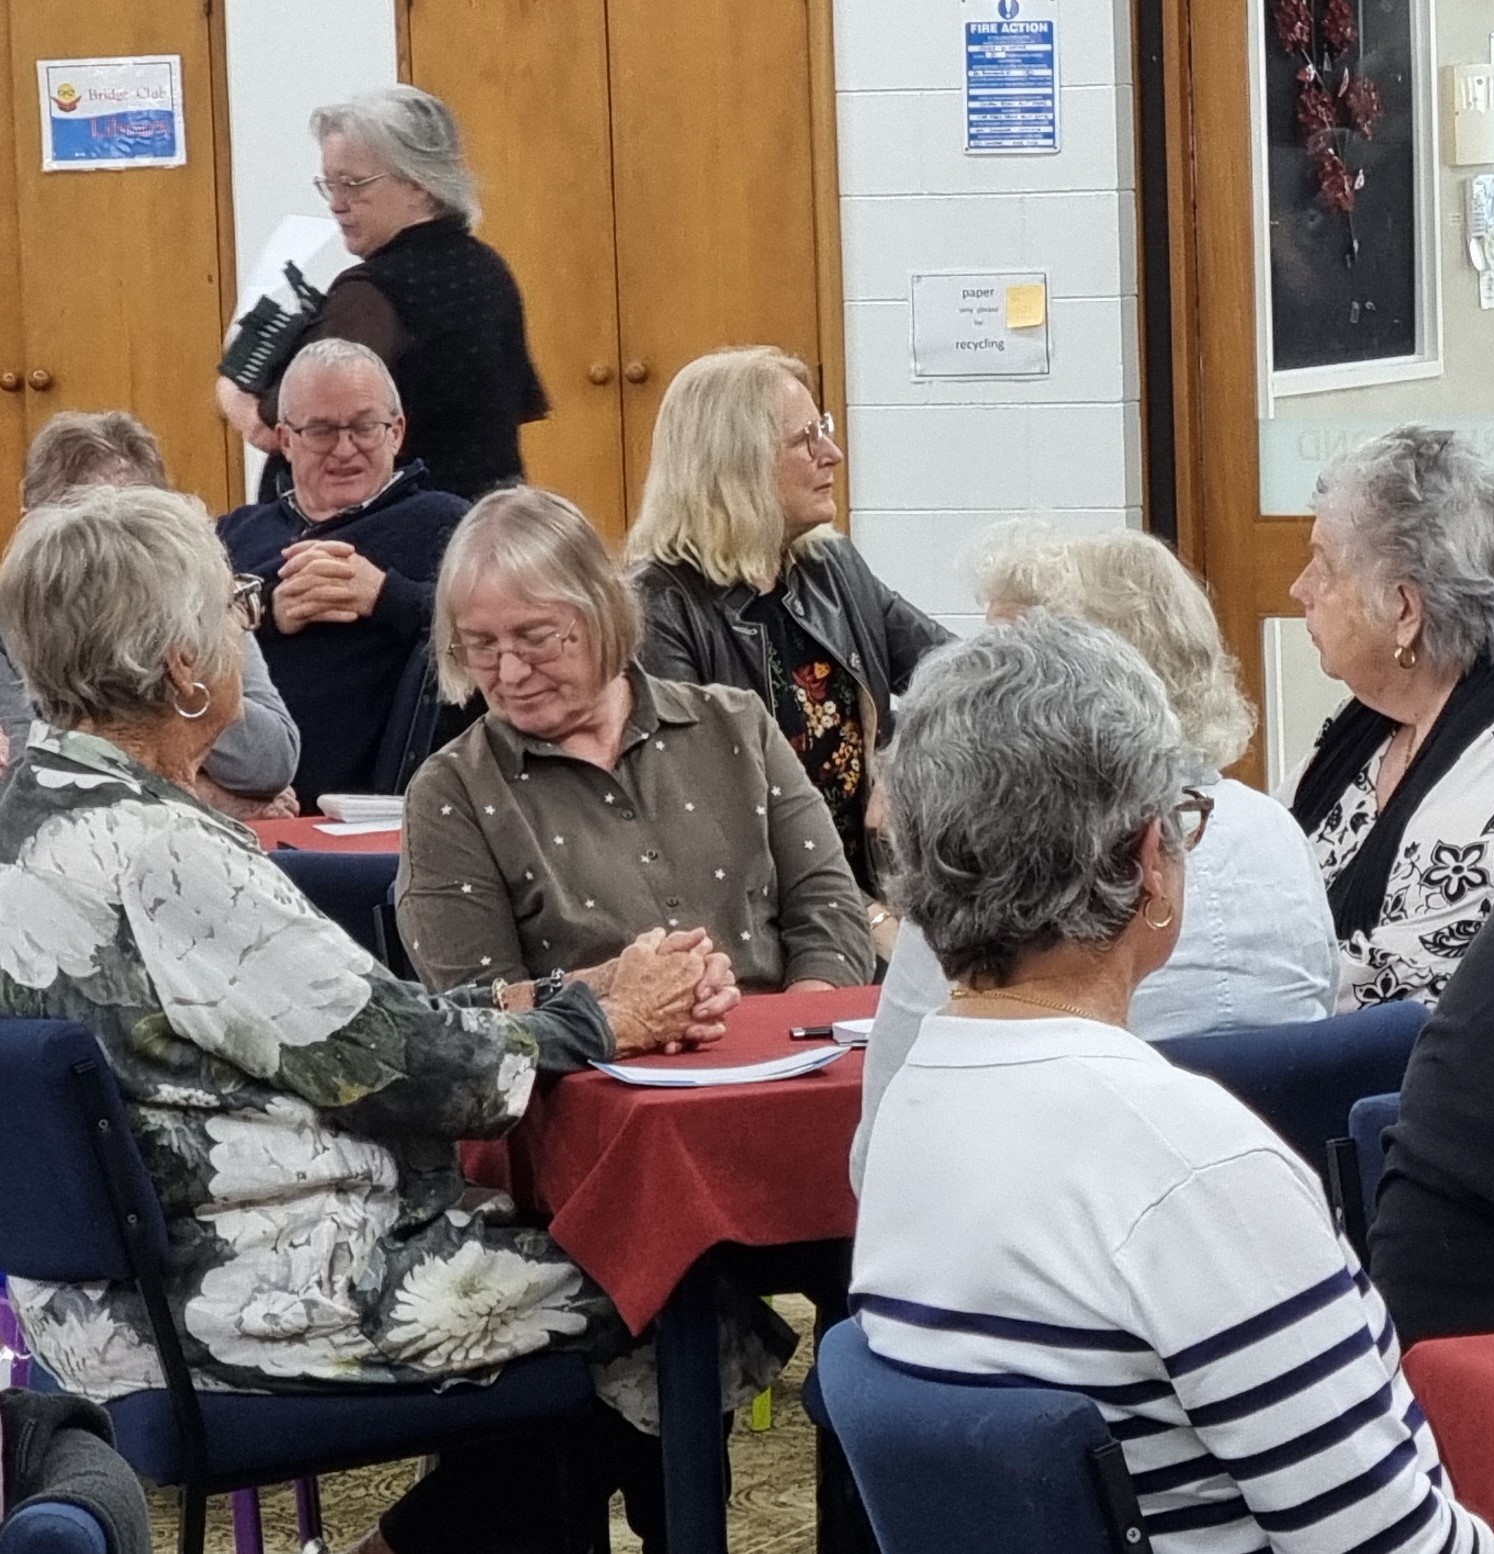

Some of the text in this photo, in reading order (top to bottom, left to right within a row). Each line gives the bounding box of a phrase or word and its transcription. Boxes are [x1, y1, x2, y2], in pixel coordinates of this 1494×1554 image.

[970, 22, 1048, 34] FIRE ACTION
[88, 86, 167, 102] Bridge Club
[962, 288, 994, 299] paper
[955, 338, 1005, 352] recycling
